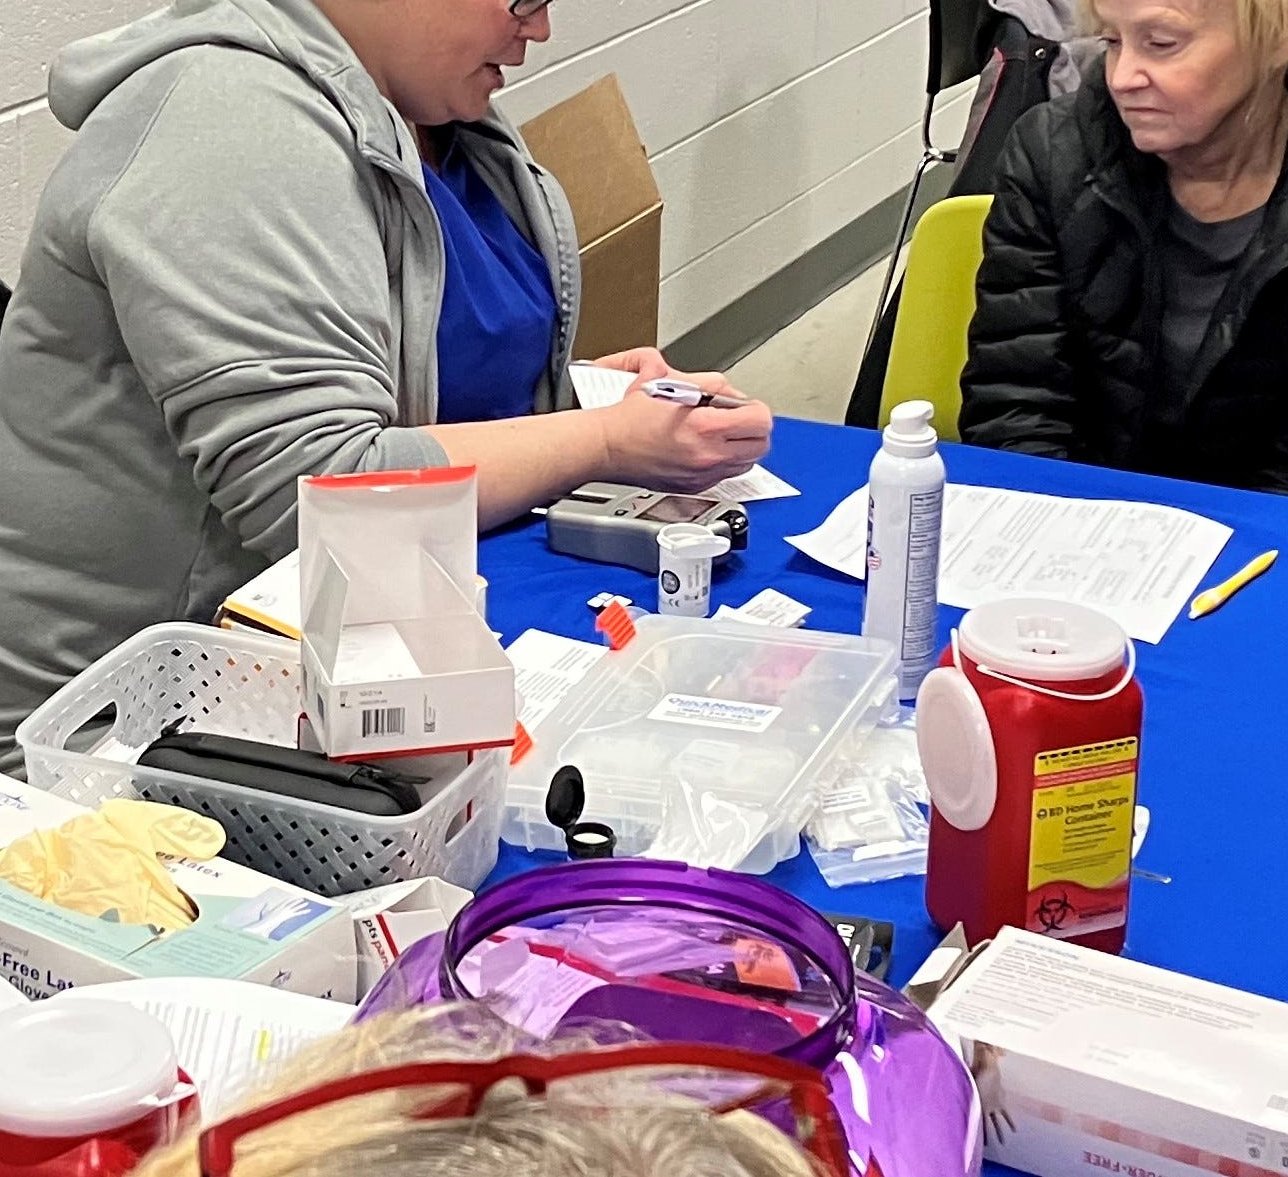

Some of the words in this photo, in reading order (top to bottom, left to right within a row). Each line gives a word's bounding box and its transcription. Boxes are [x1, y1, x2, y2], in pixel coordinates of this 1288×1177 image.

[1066, 803, 1095, 814] Home
[1097, 797, 1129, 809] Sharps
[1065, 810, 1114, 825] Container
[362, 919, 377, 939] pts
